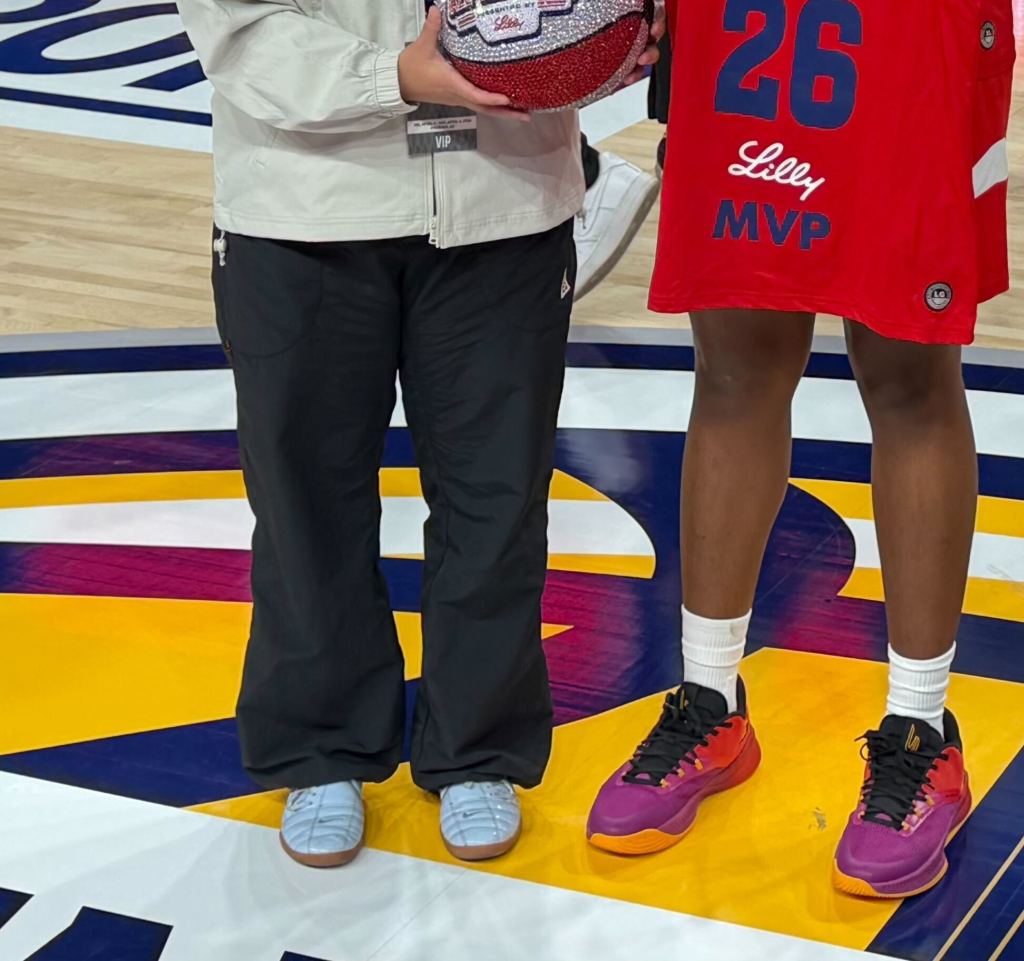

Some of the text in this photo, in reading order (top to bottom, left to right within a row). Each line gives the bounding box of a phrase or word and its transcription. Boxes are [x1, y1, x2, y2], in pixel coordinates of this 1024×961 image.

[435, 135, 452, 149] VIP
[727, 140, 825, 201] Lilly
[712, 199, 831, 251] MVP
